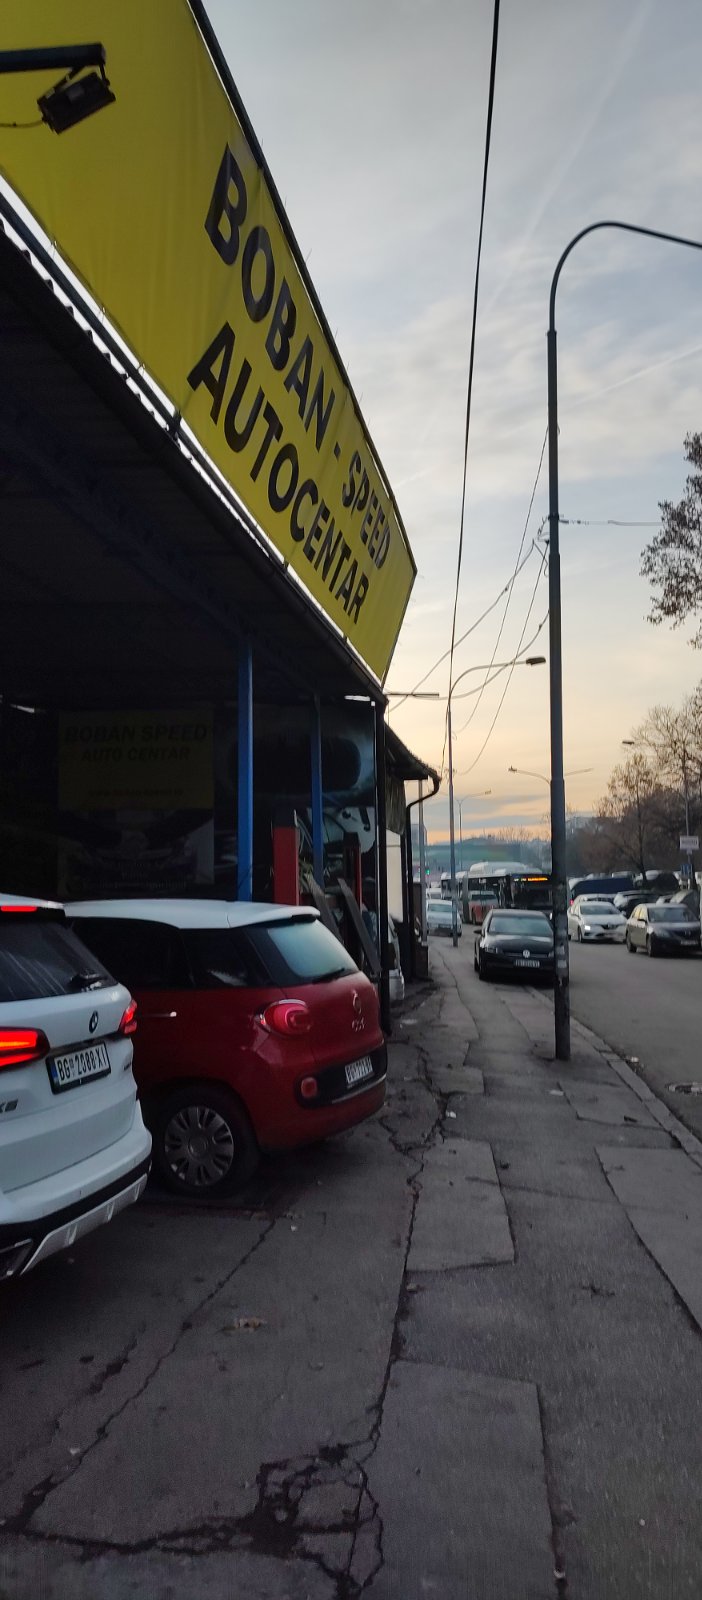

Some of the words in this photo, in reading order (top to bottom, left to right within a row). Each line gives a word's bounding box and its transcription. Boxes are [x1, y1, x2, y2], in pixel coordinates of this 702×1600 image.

[204, 142, 335, 452] BOBAN
[342, 449, 390, 570] SPEED
[187, 321, 370, 625] AUTOCENTAR
[64, 724, 136, 743] BOBAN
[141, 723, 207, 742] SPEED
[81, 747, 122, 762] AUTO
[127, 746, 191, 761] CENTAR
[57, 1059, 71, 1081] BG
